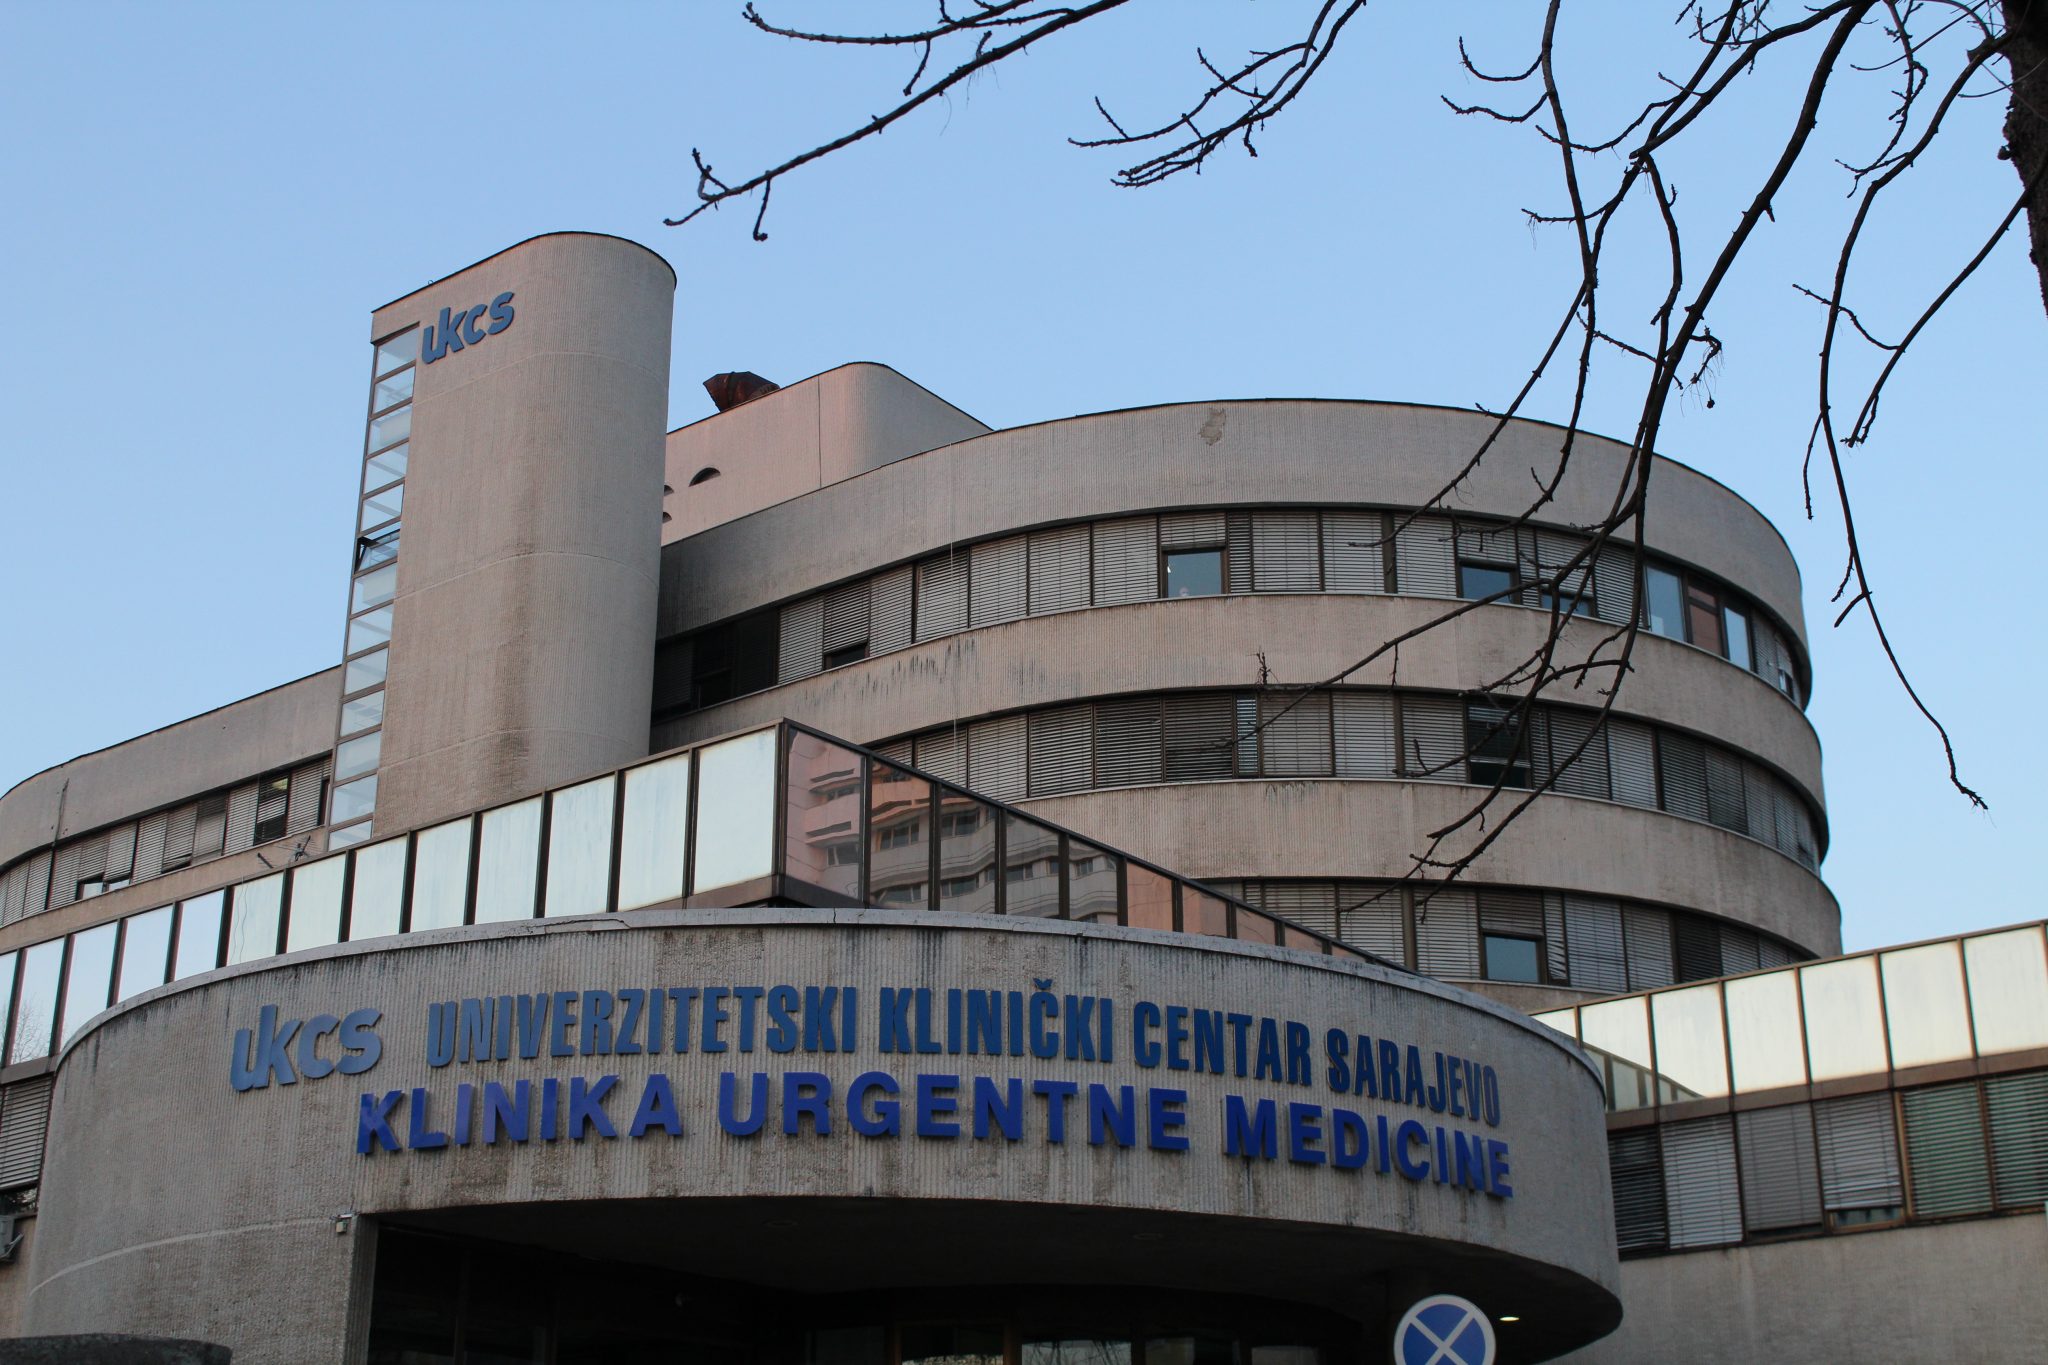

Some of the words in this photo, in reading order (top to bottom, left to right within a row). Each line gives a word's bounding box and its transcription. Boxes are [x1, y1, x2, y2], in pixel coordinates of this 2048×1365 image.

[427, 985, 857, 1067] UNIVERZITETSKI
[878, 978, 1113, 1062] KLINIČKI
[1133, 1001, 1312, 1086] CENTAR
[1327, 1028, 1501, 1127] SARAJEVO
[357, 1073, 683, 1154] KLINIKA
[719, 1071, 1190, 1151] URGENTNE
[1222, 1094, 1514, 1198] MEDICINE
